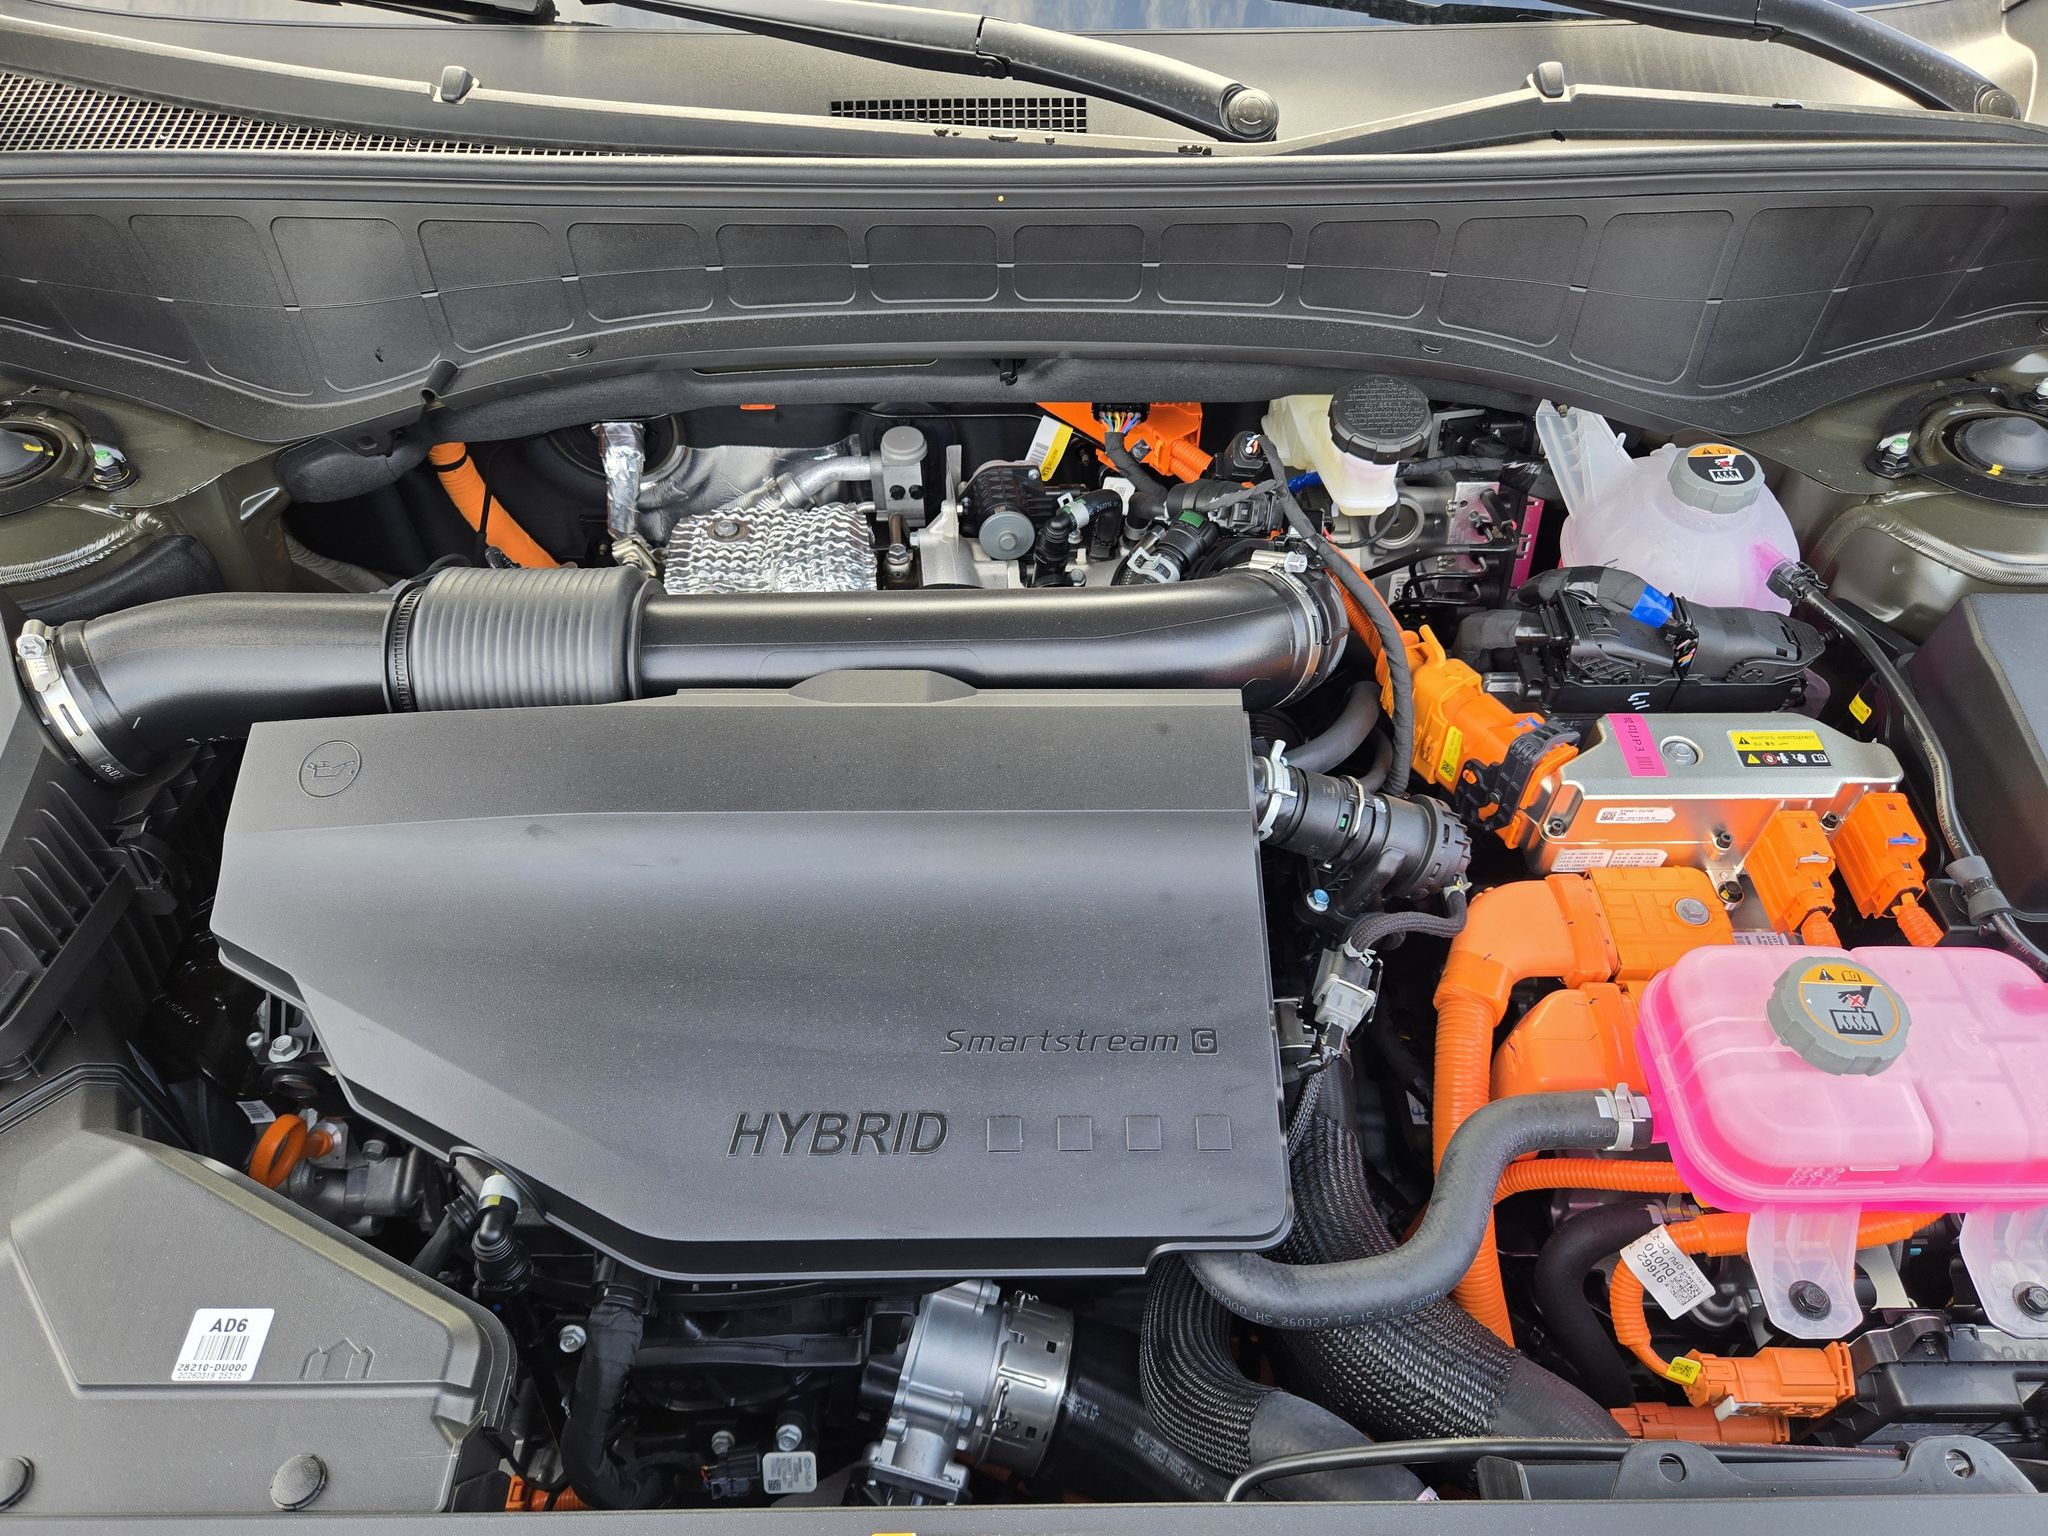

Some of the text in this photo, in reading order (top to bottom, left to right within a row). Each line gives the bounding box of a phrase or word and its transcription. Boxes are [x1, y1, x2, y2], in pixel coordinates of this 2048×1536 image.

[940, 1028, 1180, 1055] Smartstream
[727, 1110, 949, 1157] HYBRID
[1637, 1251, 1667, 1284] 91662
[1645, 1243, 1675, 1277] DU010
[209, 1318, 248, 1333] AD6
[1255, 1311, 1273, 1324] HS
[1281, 1316, 1329, 1327] 260327
[177, 1363, 248, 1372] 28210-DU000
